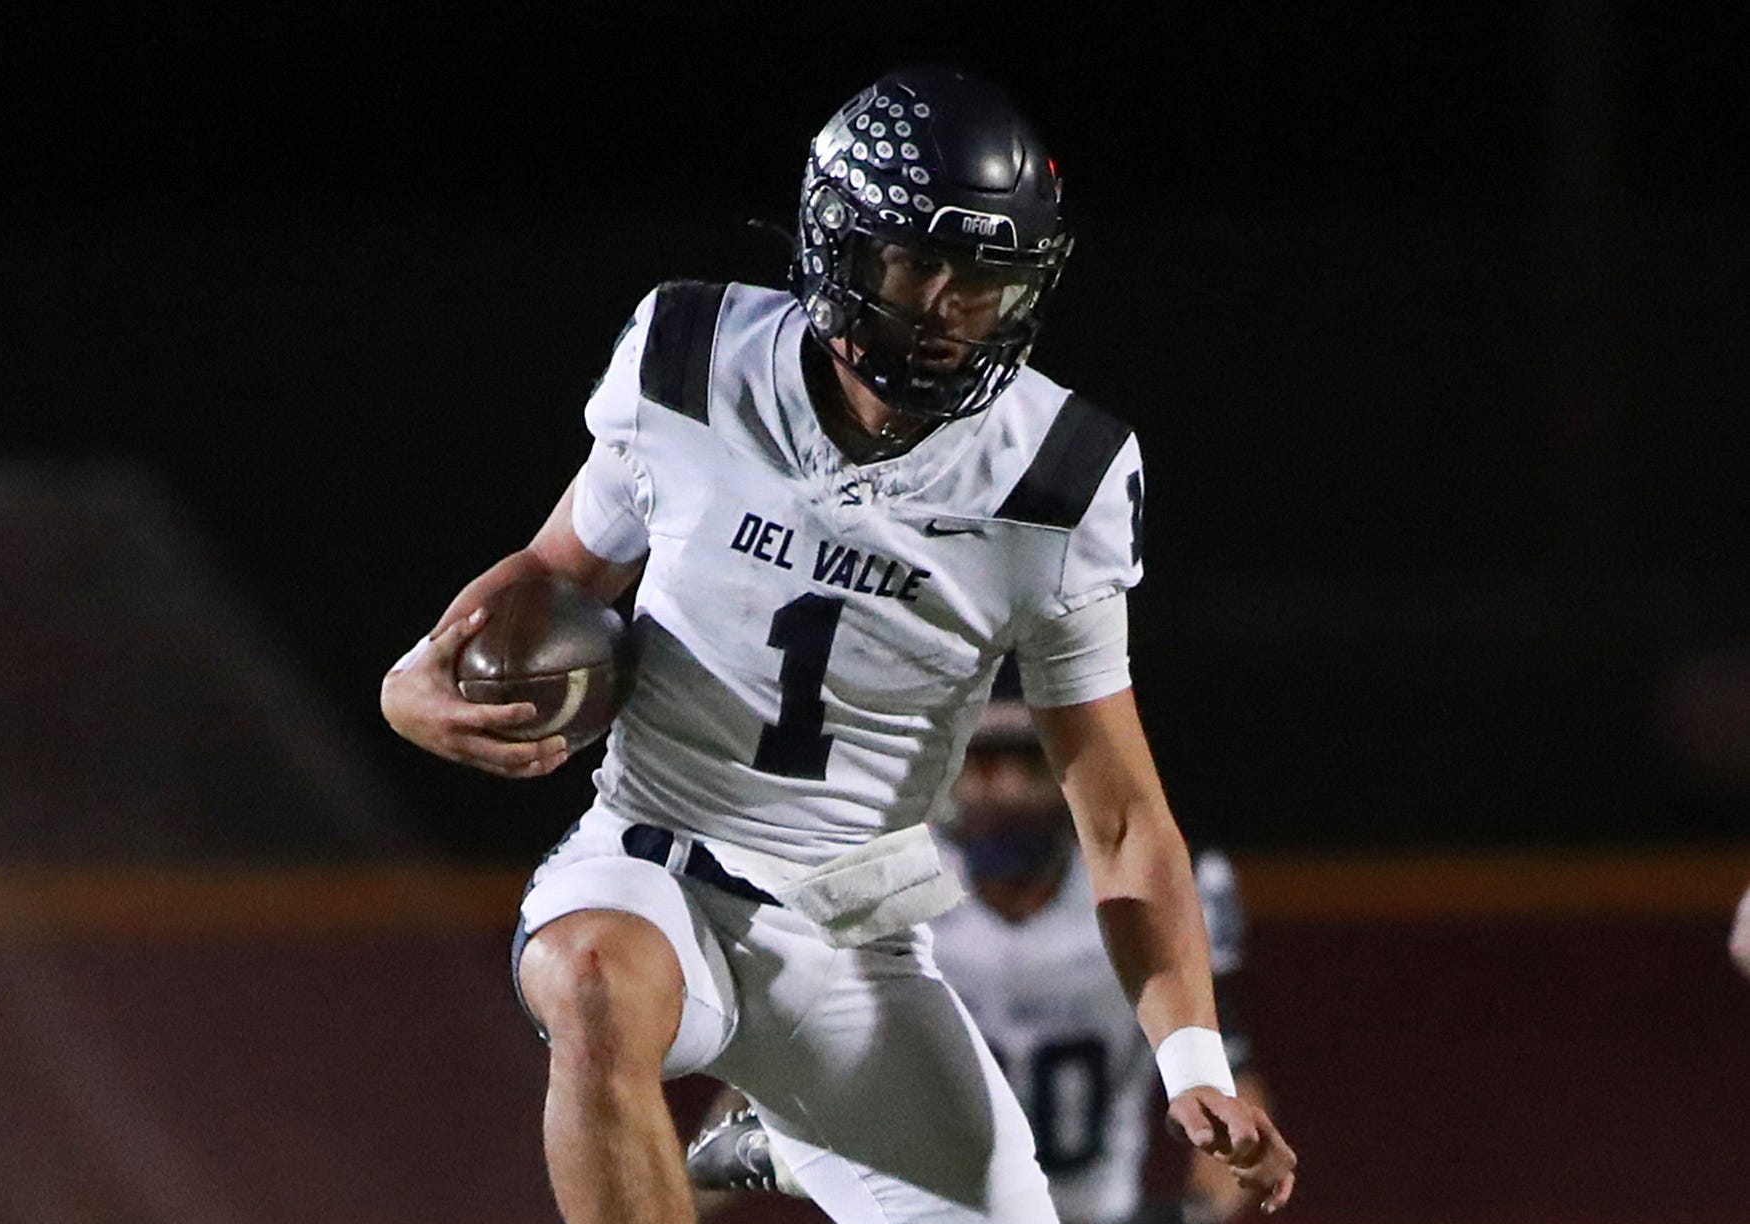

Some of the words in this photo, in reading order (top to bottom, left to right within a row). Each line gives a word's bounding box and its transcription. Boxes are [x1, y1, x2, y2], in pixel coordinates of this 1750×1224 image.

[731, 512, 794, 570] DEL
[812, 540, 932, 602] VALLE
[751, 591, 845, 782] 1
